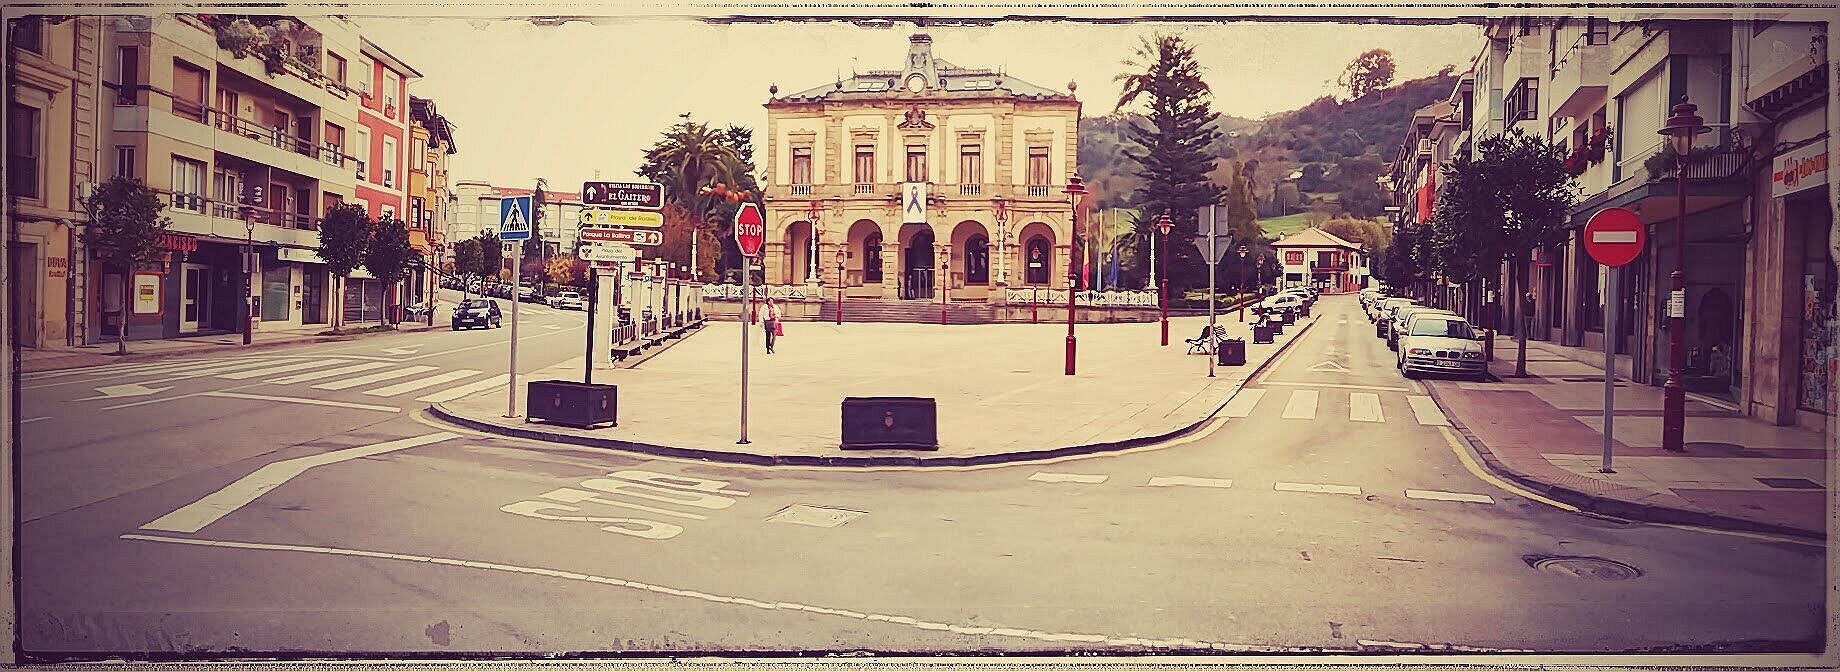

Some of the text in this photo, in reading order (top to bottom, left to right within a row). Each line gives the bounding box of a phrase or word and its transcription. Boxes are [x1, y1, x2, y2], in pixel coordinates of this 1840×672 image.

[608, 189, 651, 203] EL GAITERO
[738, 223, 762, 237] STOP
[499, 470, 751, 540] STOP
